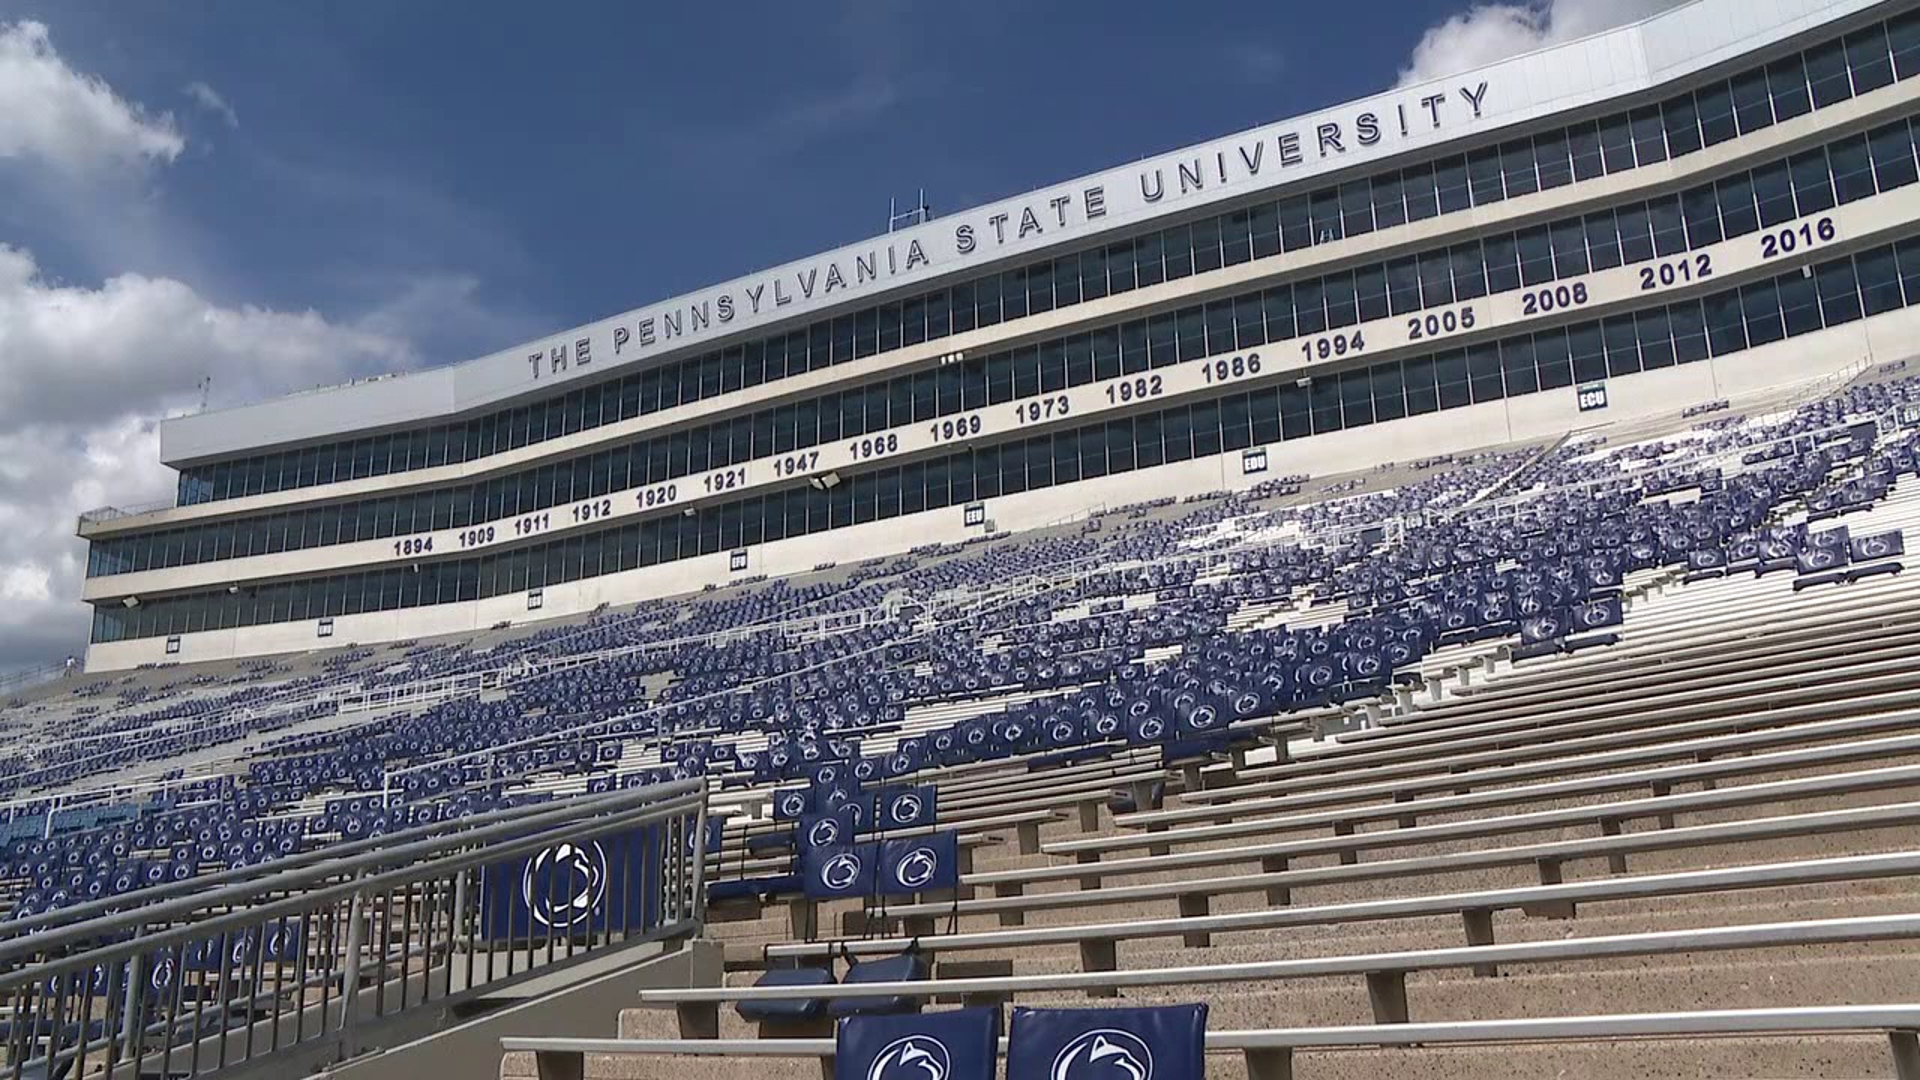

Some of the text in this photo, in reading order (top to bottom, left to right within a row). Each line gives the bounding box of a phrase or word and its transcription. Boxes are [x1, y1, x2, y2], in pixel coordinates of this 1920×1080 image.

[528, 81, 1488, 379] THE PENNSYLVANIA STATE UNIVERSITY
[1760, 217, 1835, 259] 2016
[1639, 253, 1713, 291] 2012
[1522, 282, 1588, 316] 2008
[1407, 306, 1475, 340] 2005
[1301, 330, 1365, 362] 1994
[1201, 353, 1261, 384] 1986
[1106, 374, 1163, 404] 1982
[1580, 390, 1605, 408] ECU
[1015, 395, 1069, 424] 1973
[930, 414, 981, 442] 1969
[849, 433, 898, 460] 1968
[773, 451, 819, 477] 1947
[704, 467, 745, 493] 1921
[636, 484, 677, 508] 1920
[514, 513, 549, 535] 1911
[572, 499, 611, 523] 1912
[394, 536, 433, 557] 1894
[458, 526, 495, 547] 1909
